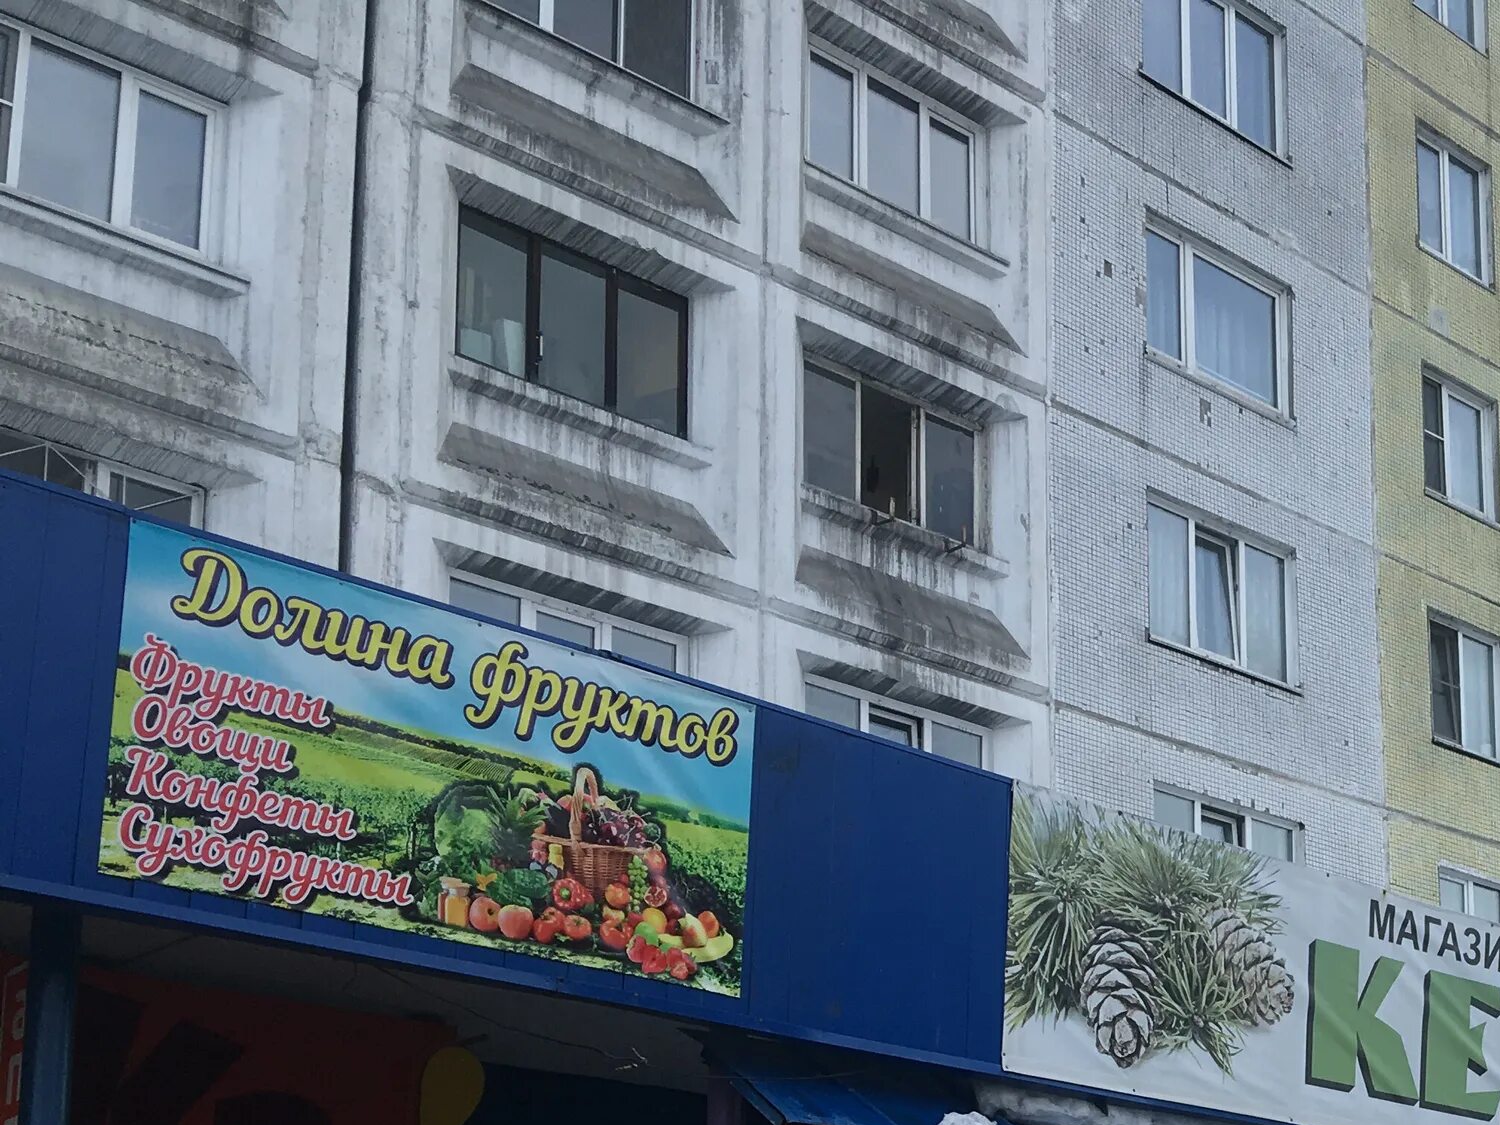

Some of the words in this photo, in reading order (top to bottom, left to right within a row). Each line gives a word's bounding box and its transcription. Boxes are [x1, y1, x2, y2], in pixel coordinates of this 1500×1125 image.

[130, 634, 331, 729] Фрукты
[171, 546, 454, 690] Долина
[463, 641, 740, 766] фруктов
[133, 694, 294, 773] Овощи
[125, 746, 357, 841] Конфеты
[119, 805, 414, 906] Сухофрукты
